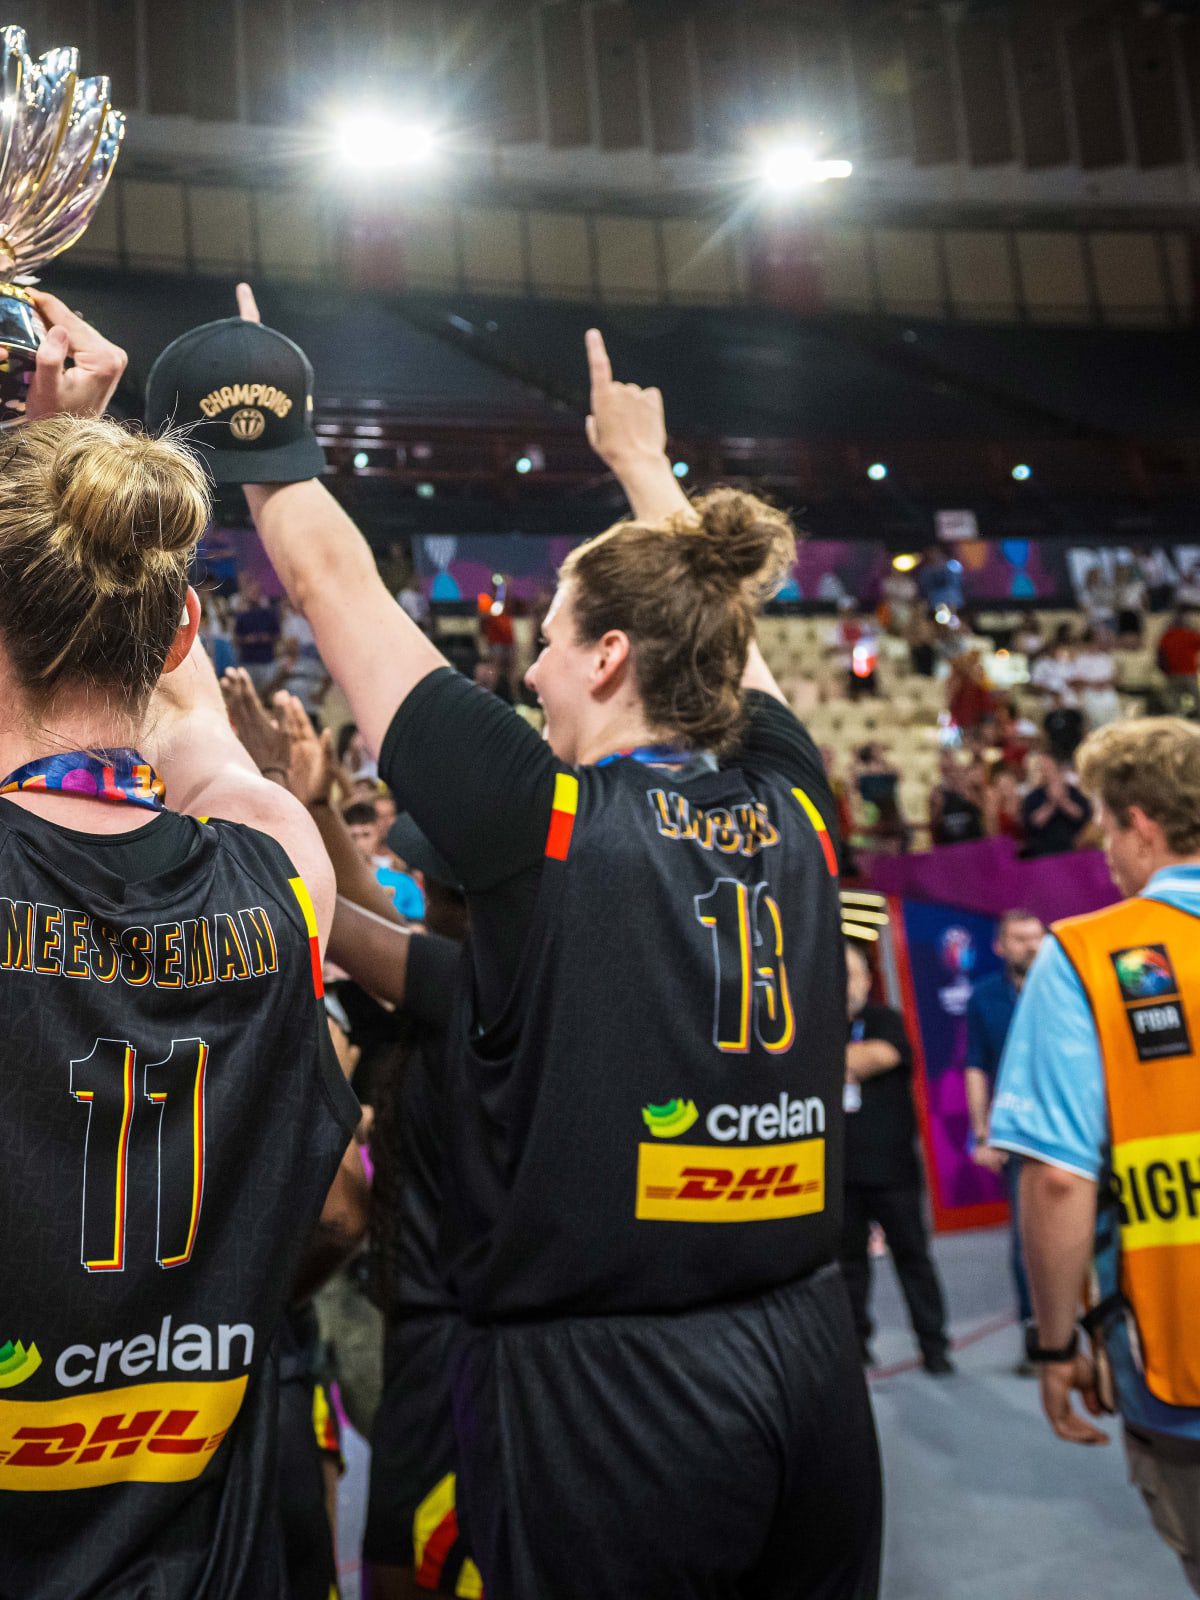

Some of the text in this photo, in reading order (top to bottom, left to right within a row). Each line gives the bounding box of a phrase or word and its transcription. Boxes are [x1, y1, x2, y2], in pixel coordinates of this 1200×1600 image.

[199, 383, 293, 418] CHAMPIONS
[693, 877, 796, 1054] 13
[706, 1091, 826, 1142] crelan
[69, 1037, 209, 1273] 11
[674, 1162, 805, 1203] DHL
[54, 1314, 255, 1388] crelan
[4, 1409, 209, 1468] DHL
